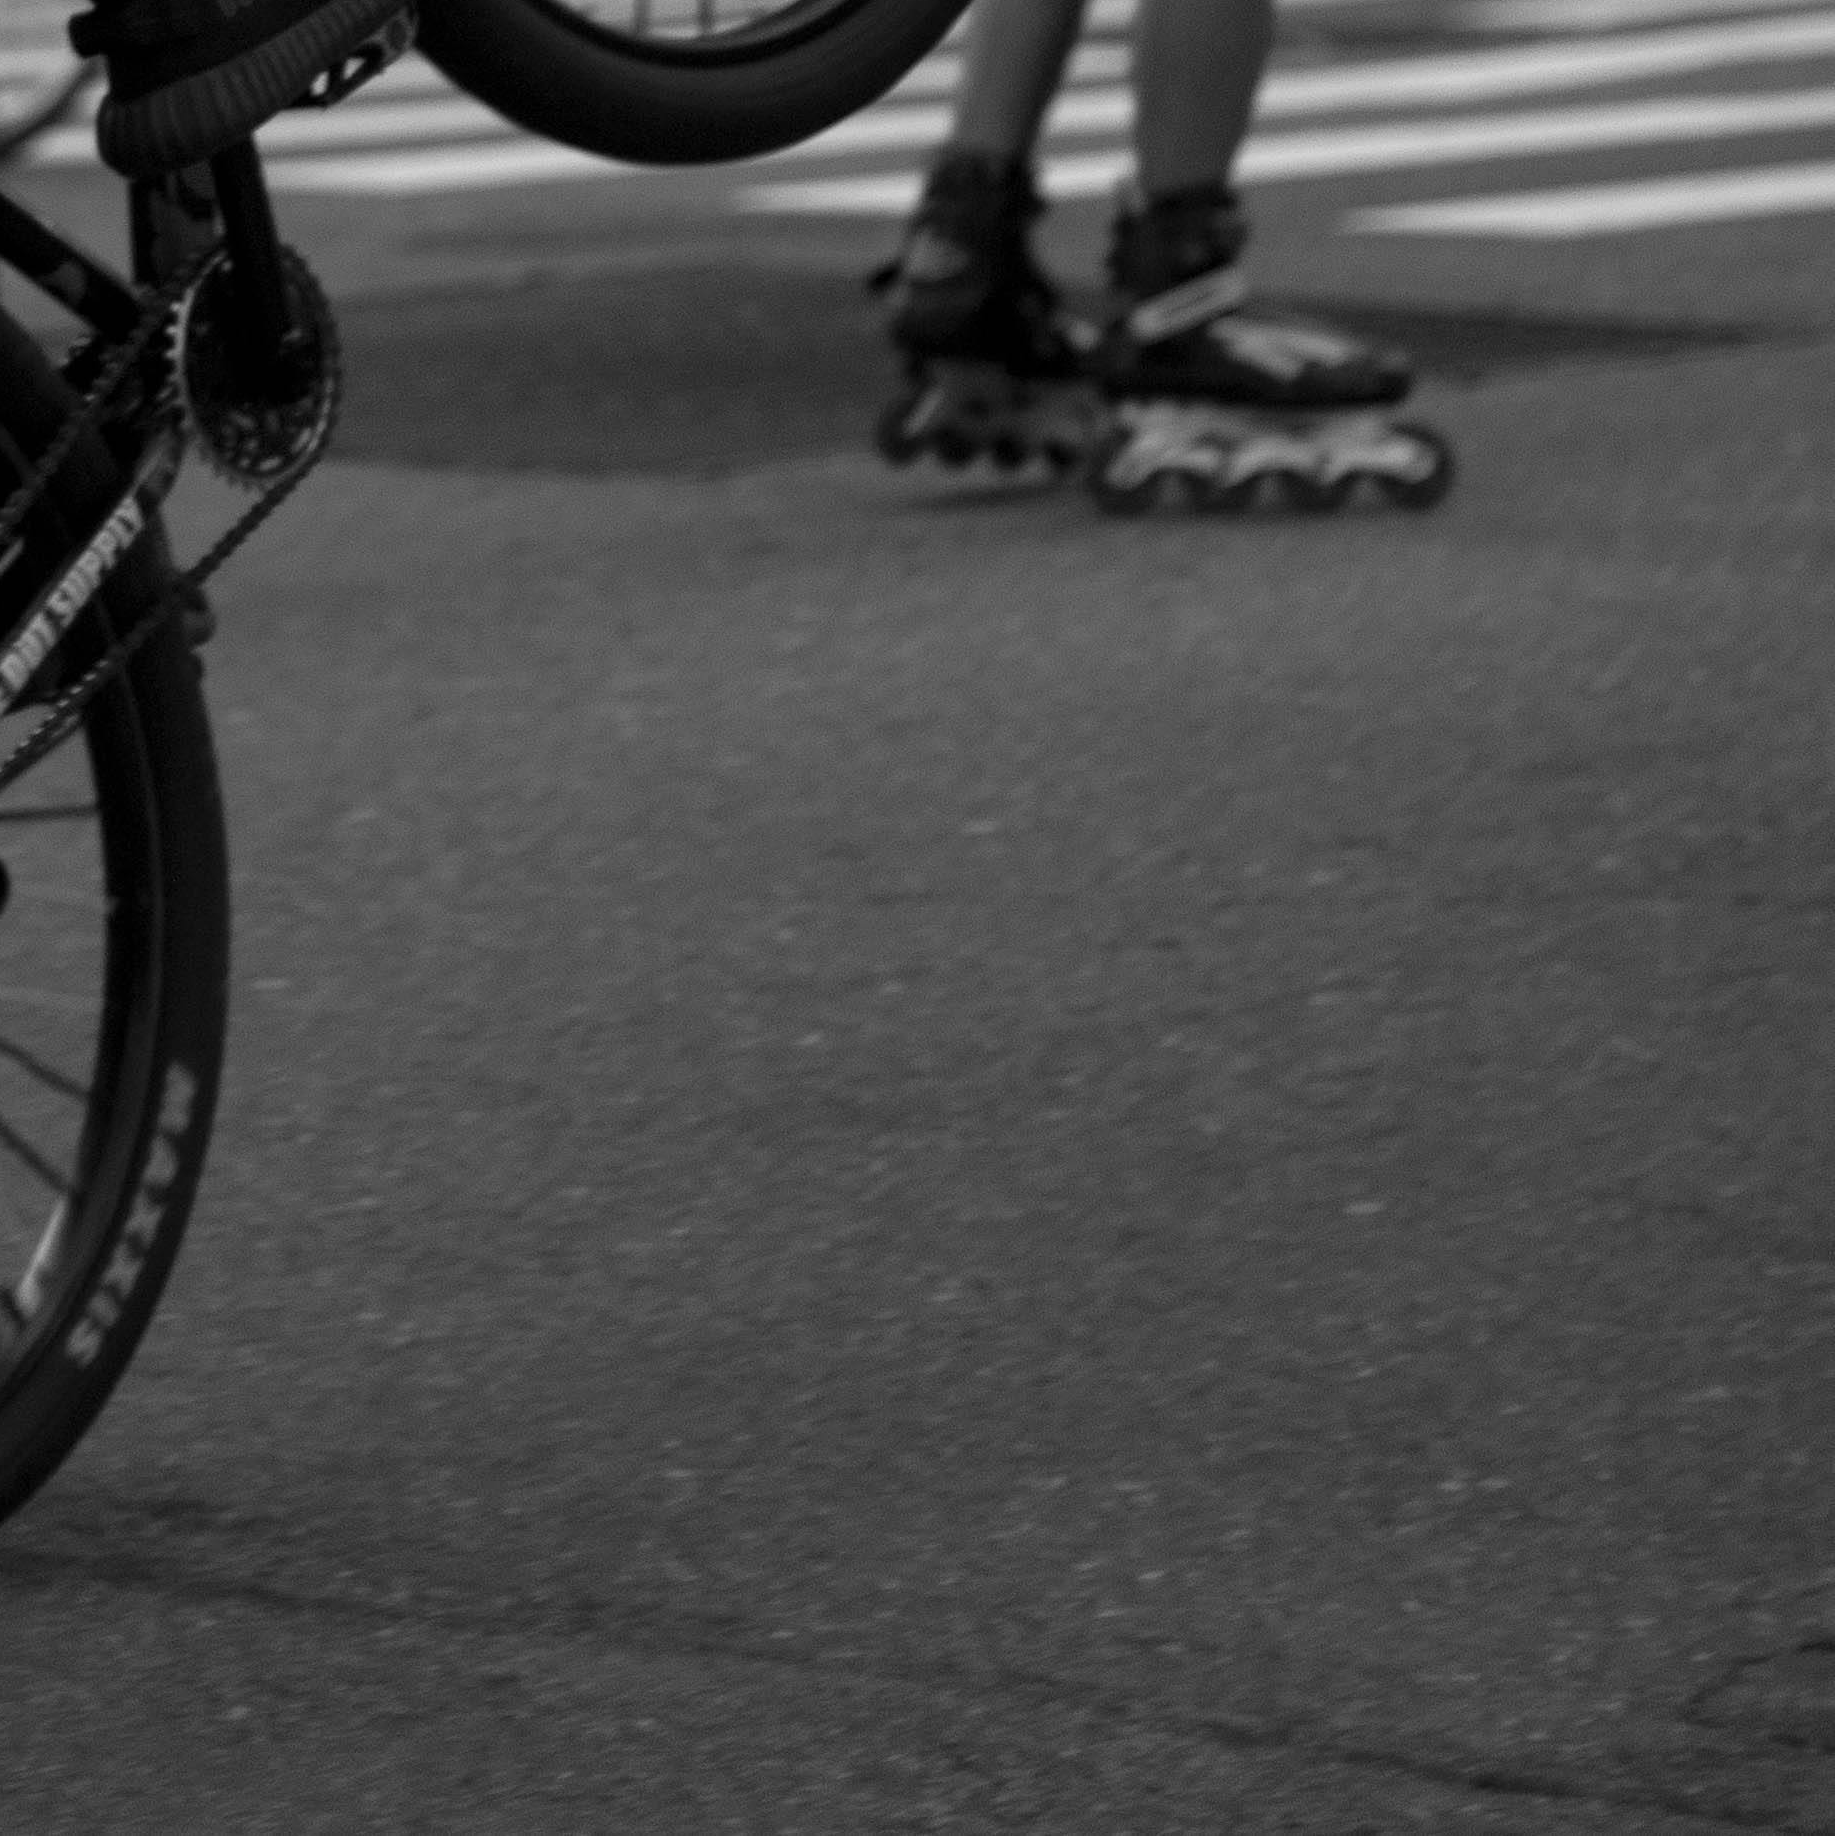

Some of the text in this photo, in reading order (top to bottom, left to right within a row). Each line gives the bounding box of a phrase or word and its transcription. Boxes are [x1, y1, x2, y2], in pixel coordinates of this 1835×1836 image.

[0, 611, 57, 692] OUT
[46, 495, 144, 629] SUPPLY
[68, 1060, 198, 1368] MAXXIS
